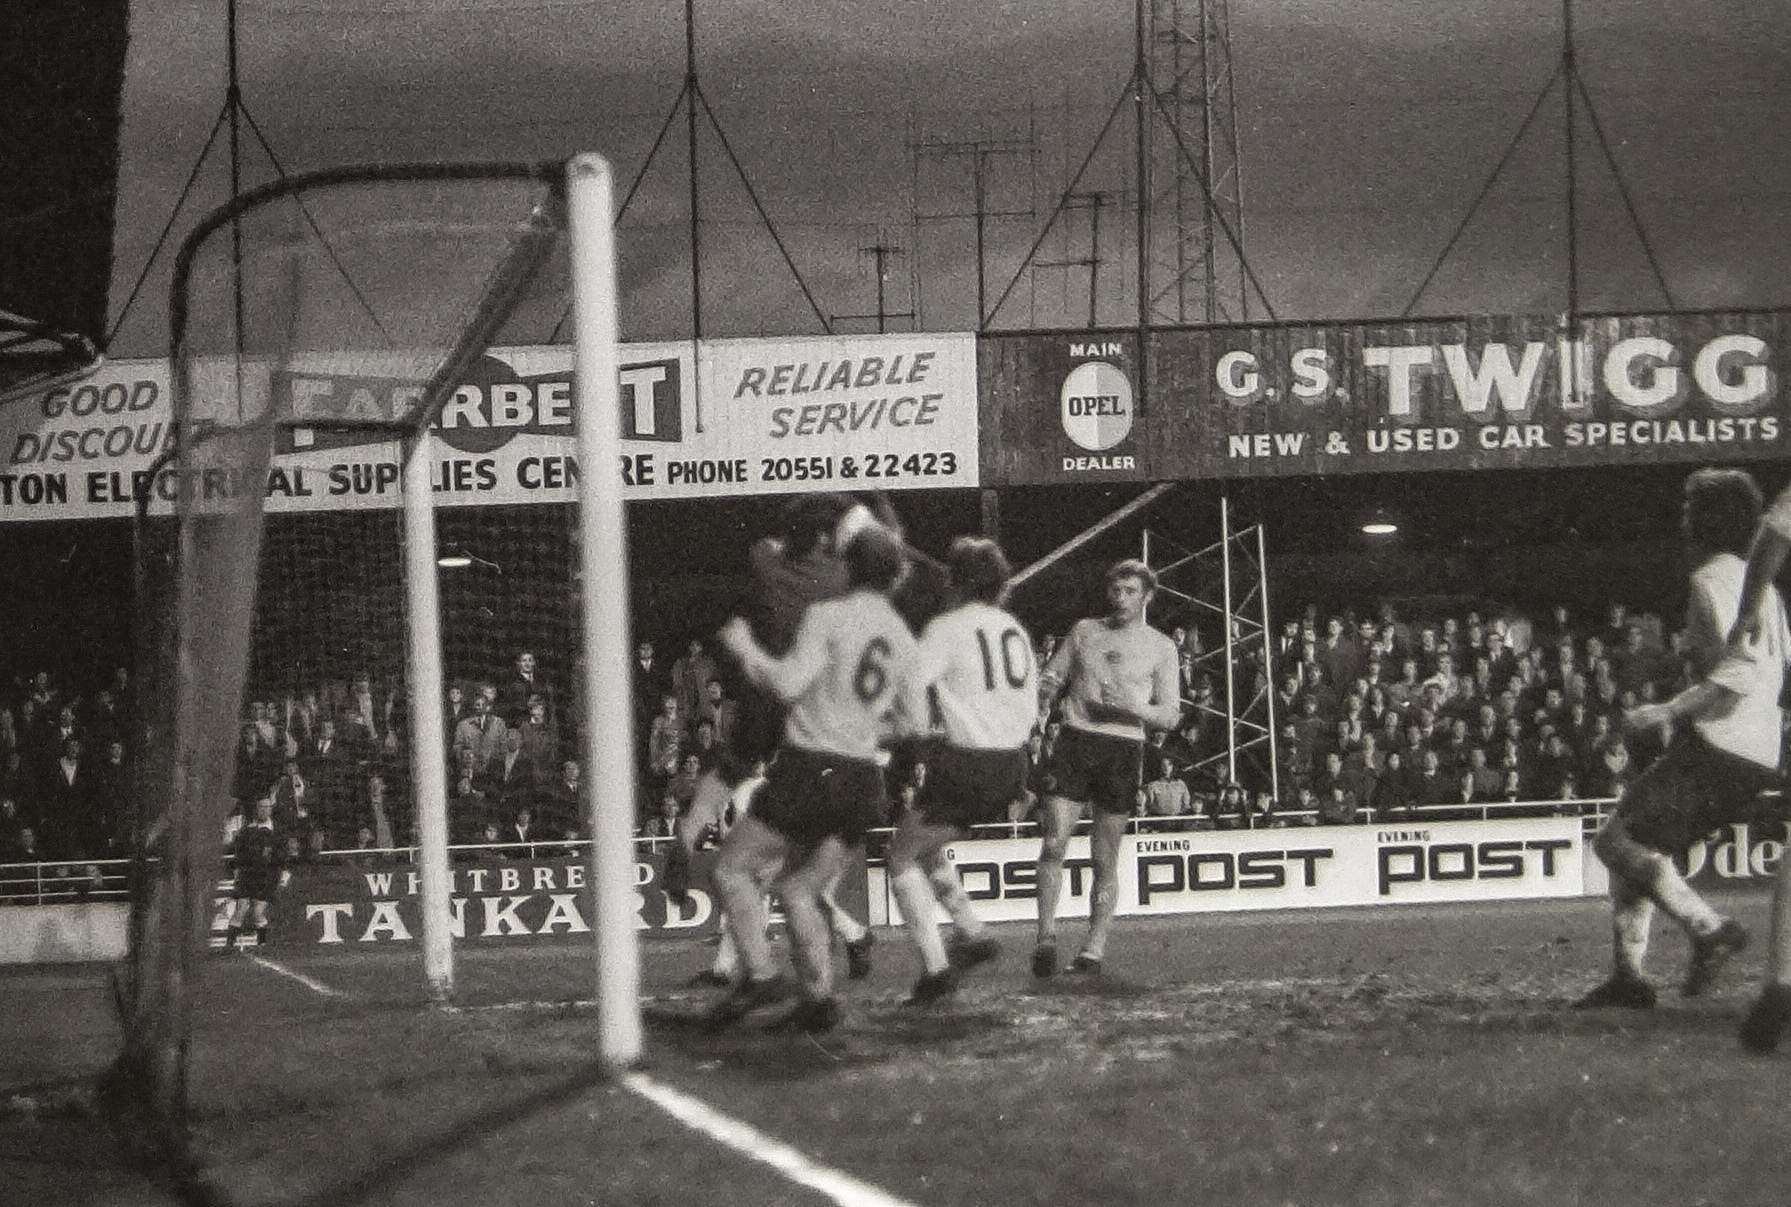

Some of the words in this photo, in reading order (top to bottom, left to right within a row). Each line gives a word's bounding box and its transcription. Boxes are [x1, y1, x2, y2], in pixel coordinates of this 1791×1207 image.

[1069, 343, 1122, 357] MAIN
[733, 352, 935, 399] RELIABLE
[1363, 333, 1768, 416] TWIGG
[41, 380, 159, 418] GOOD
[769, 393, 944, 440] SERVICE
[1068, 396, 1126, 417] OPEL
[10, 422, 180, 464] DISCOU
[1228, 433, 1305, 458] NEW
[1325, 431, 1351, 455] &
[1367, 426, 1460, 453] USED
[1479, 424, 1551, 449] CAR
[1564, 416, 1779, 447] SPECIALISTS
[328, 458, 498, 495] SUPLIES
[516, 454, 655, 490] CENRE
[668, 459, 748, 485] PHONE
[761, 455, 833, 482] 20551
[841, 456, 859, 479] &
[864, 451, 958, 478] 22423
[1062, 456, 1136, 471] DEALER
[853, 635, 892, 701] 6
[976, 628, 1030, 692] 10
[1136, 839, 1191, 853] EVENING
[1377, 830, 1431, 843] EVENING
